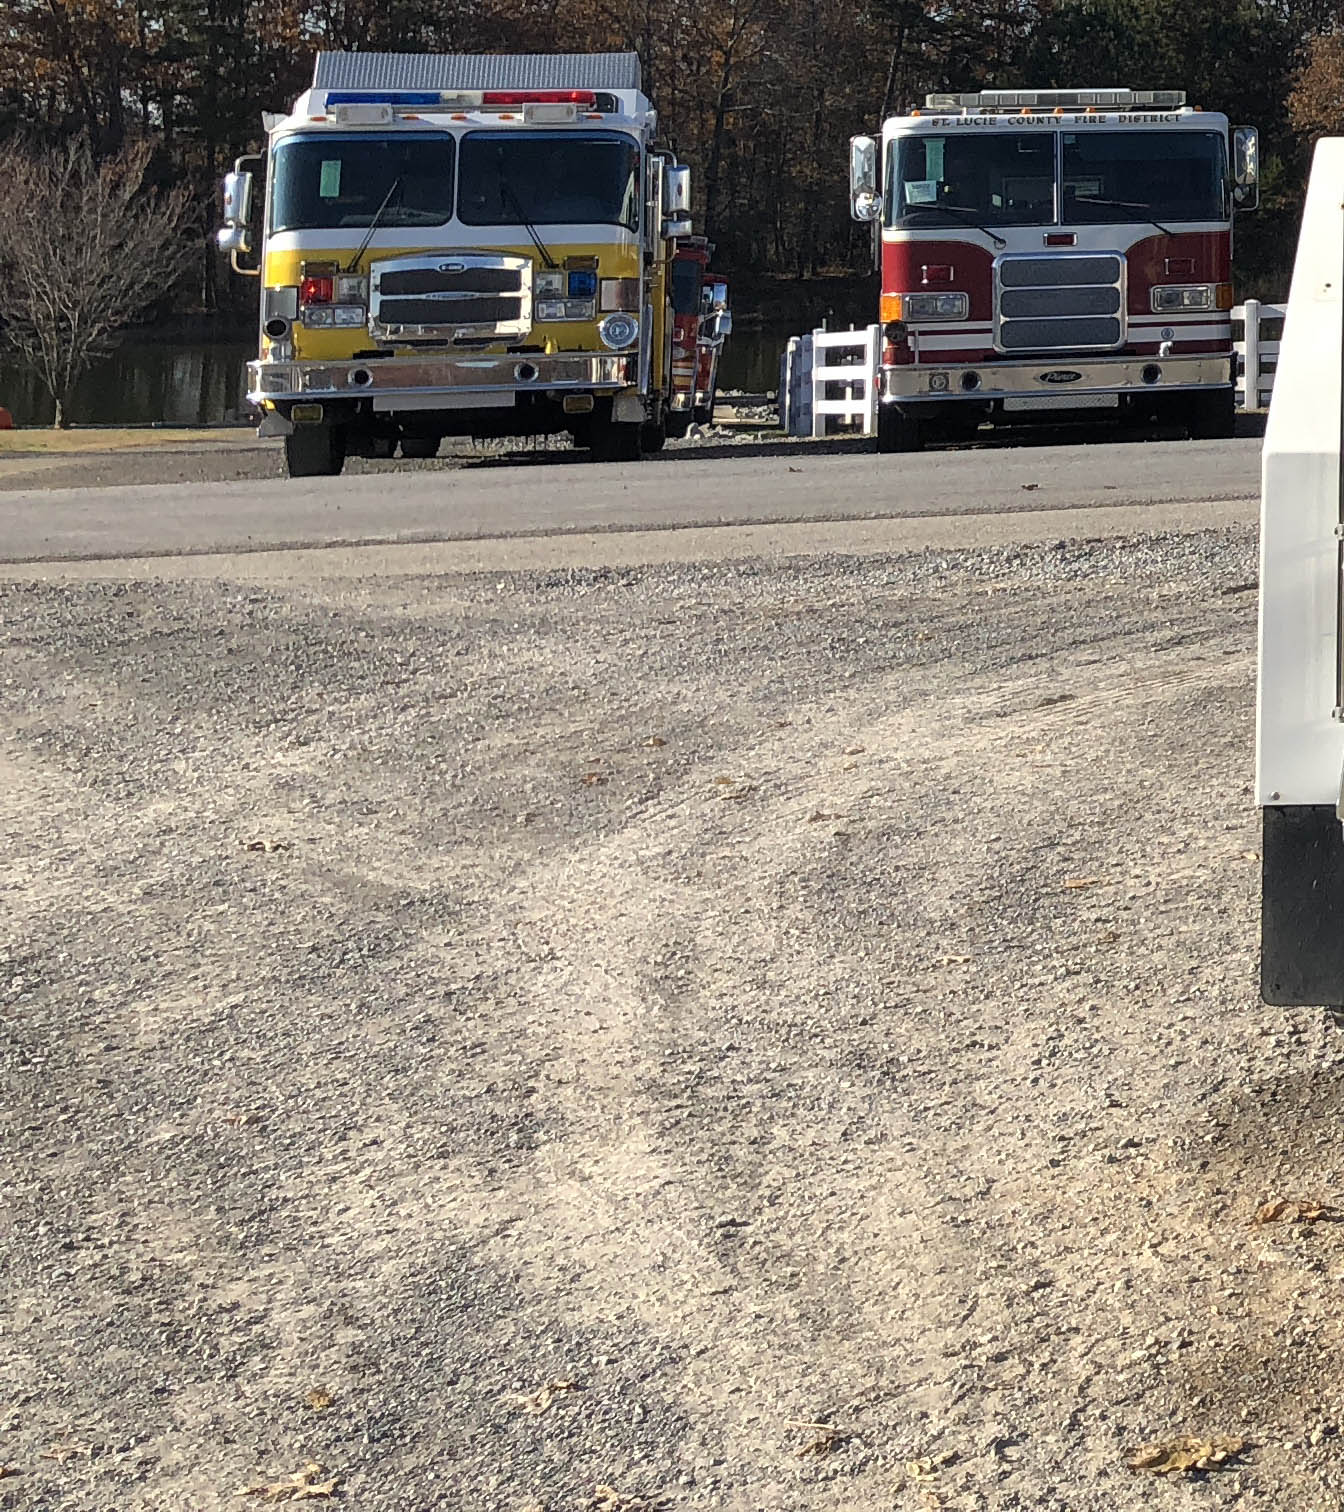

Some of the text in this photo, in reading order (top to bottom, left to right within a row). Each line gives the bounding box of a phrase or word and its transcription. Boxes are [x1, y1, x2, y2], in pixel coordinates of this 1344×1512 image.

[956, 117, 997, 126] LUCIE
[1007, 116, 1062, 125] COUNTY
[1074, 115, 1107, 124] FIRE
[1118, 114, 1182, 123] DISTRICT
